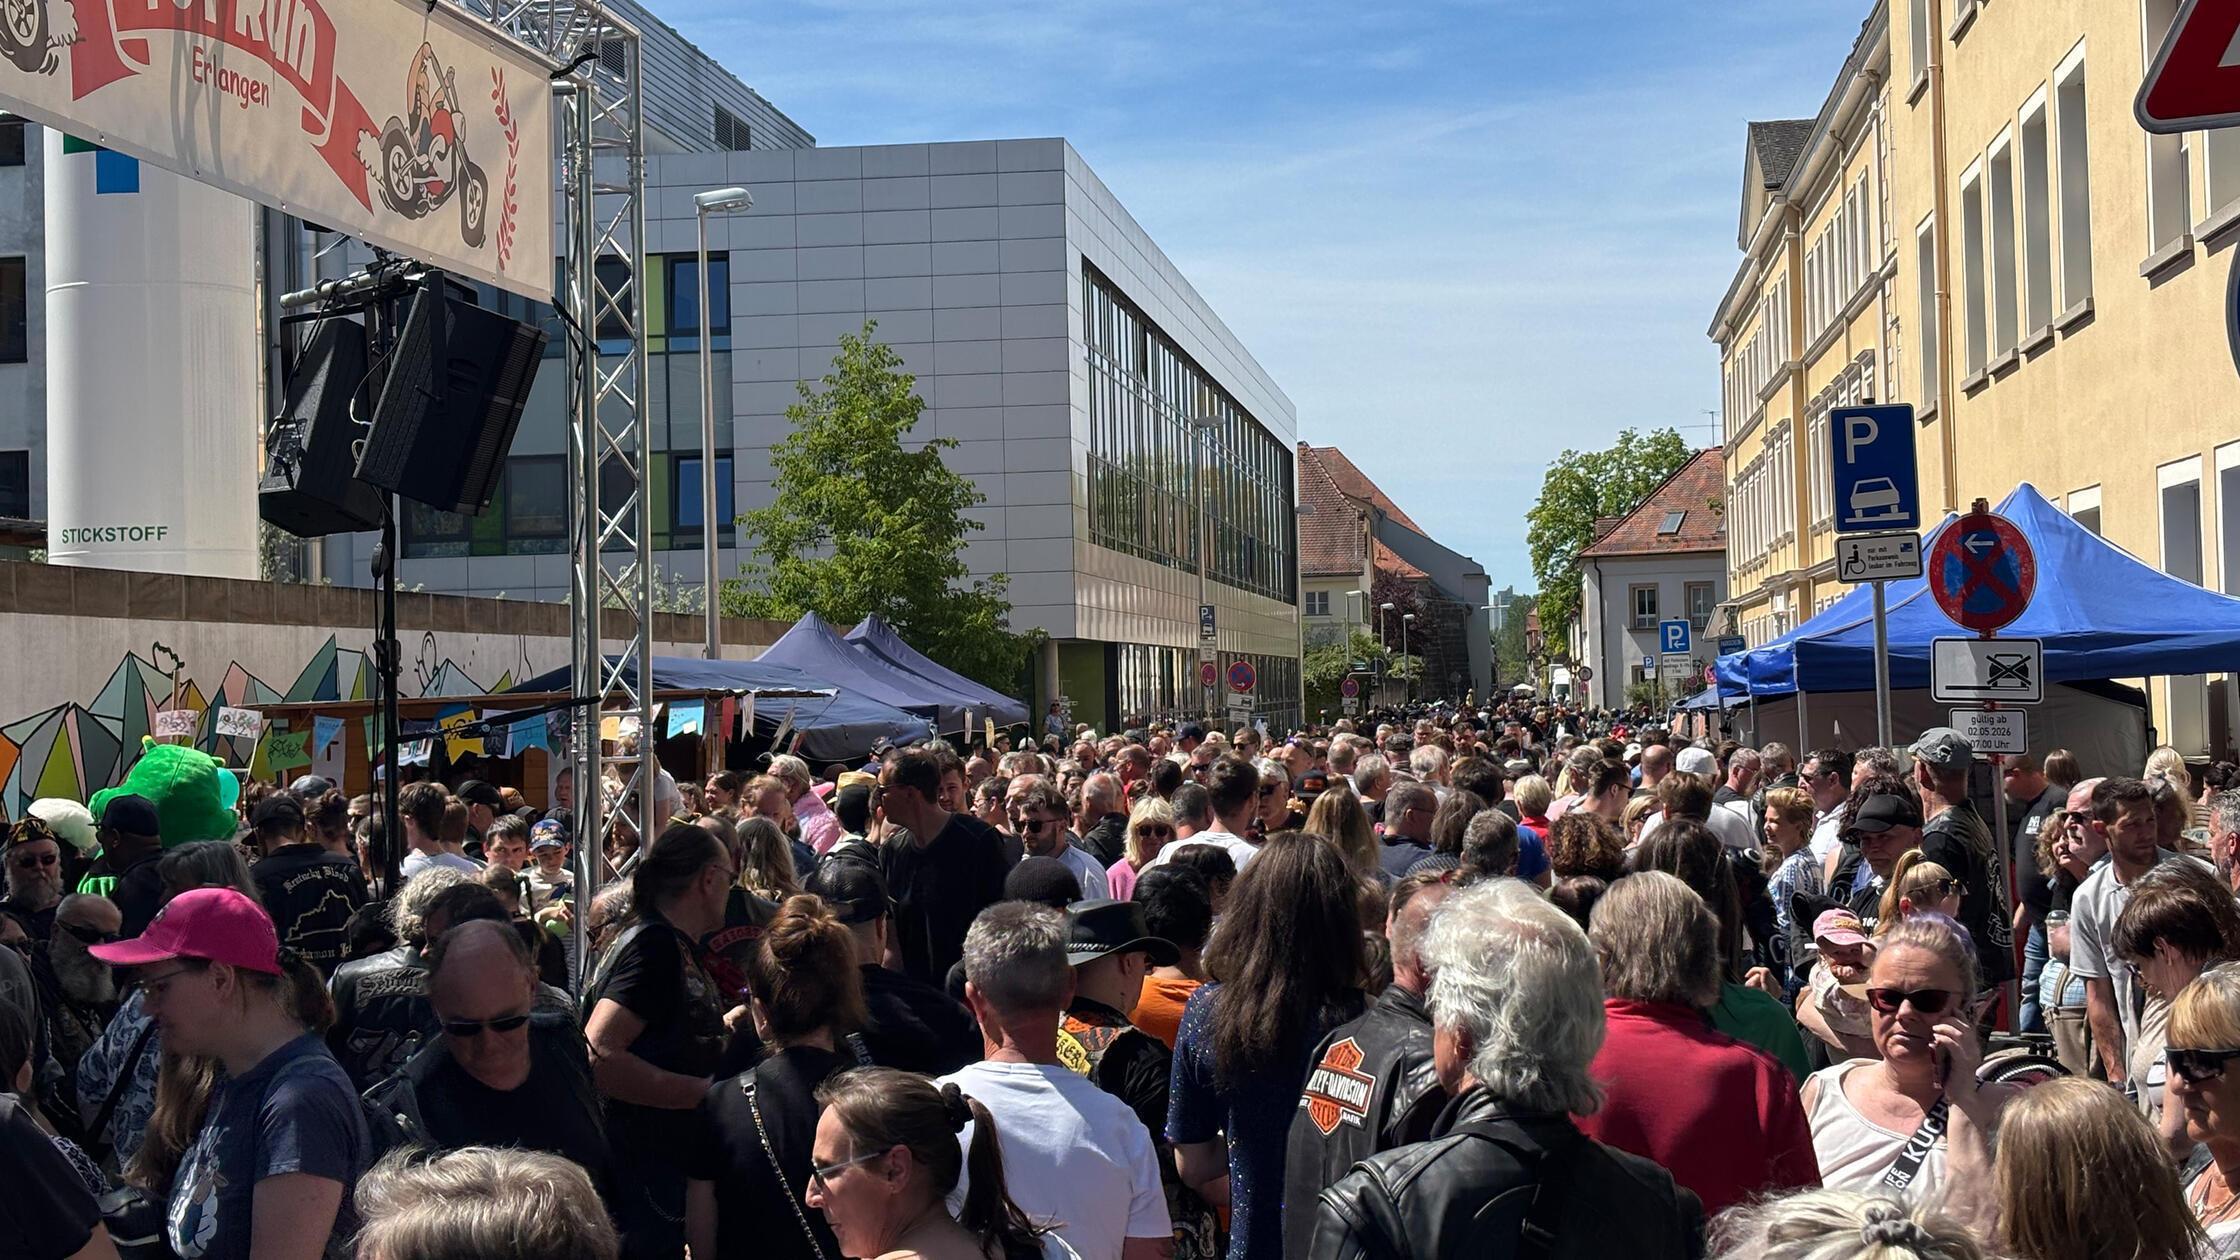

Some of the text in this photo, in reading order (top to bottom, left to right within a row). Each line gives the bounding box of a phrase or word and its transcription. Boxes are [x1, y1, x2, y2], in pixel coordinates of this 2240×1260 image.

[192, 45, 270, 109] Erlangen
[1844, 416, 1879, 464] P
[61, 526, 168, 544] STICKSTOFF
[1667, 625, 1684, 649] P
[1971, 714, 2007, 726] gültig ab
[1968, 727, 2012, 736] 02.05.2026
[1994, 740, 2010, 749] Uhr
[1884, 1167, 1903, 1187] IFE
[1894, 1170, 1912, 1190] ON
